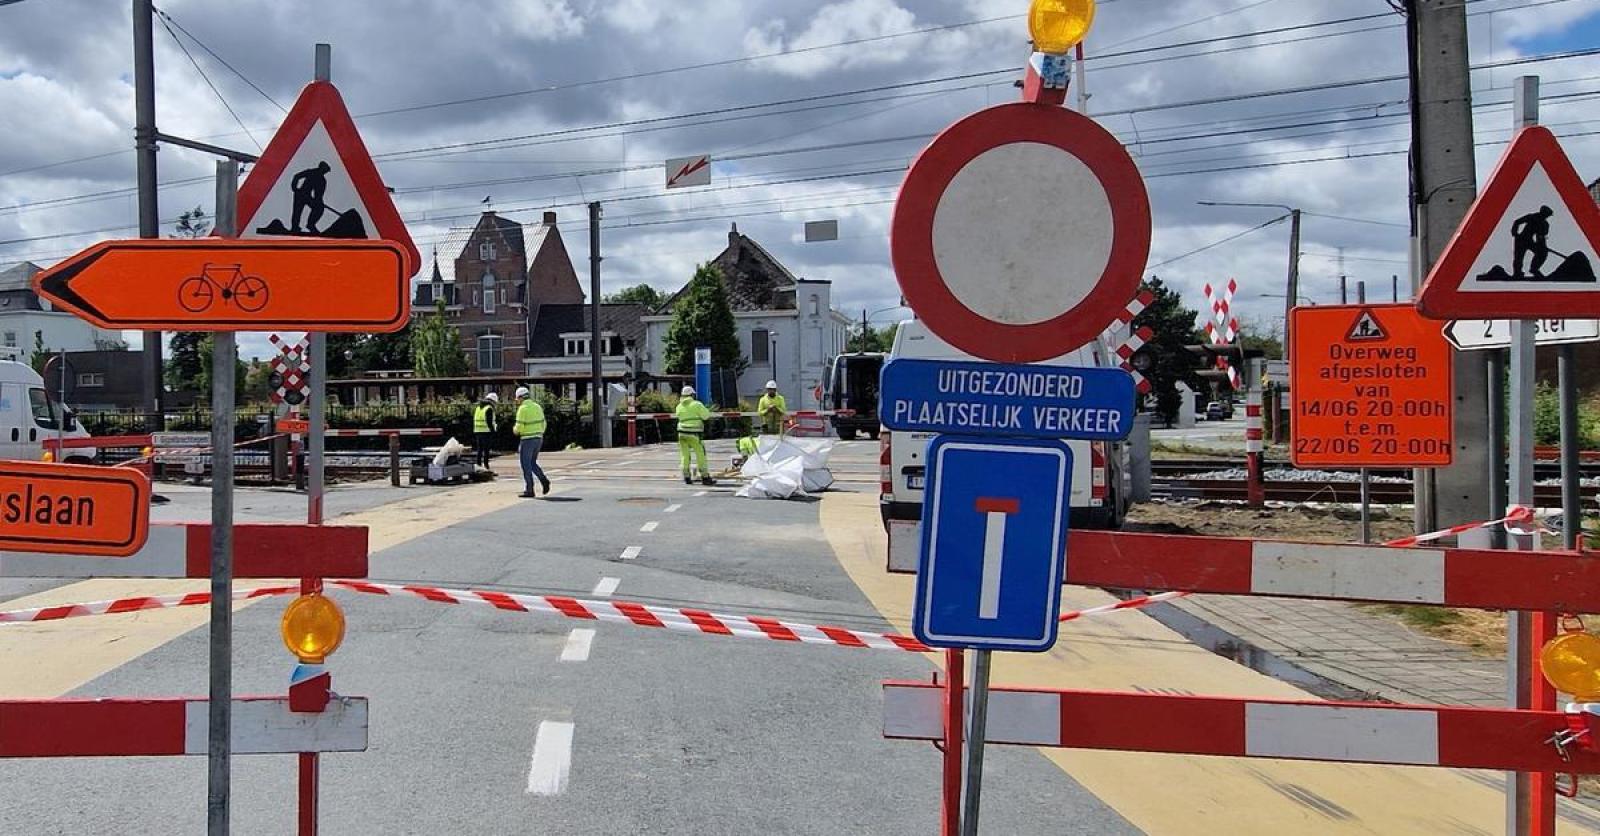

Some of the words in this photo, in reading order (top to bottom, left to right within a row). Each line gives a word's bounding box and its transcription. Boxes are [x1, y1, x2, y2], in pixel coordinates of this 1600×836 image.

[1483, 319, 1493, 338] 2
[1330, 344, 1417, 362] Overweg
[1320, 363, 1427, 382] afgesloten
[938, 369, 1083, 398] UITGEZONDERD
[1355, 384, 1390, 397] van
[894, 399, 1023, 429] PLAATSELIJK
[1033, 406, 1121, 433] VERKEER
[1301, 400, 1358, 417] 14/06
[1366, 400, 1445, 417] 20:00h
[1344, 420, 1400, 436] t.e.m.
[1297, 438, 1360, 454] 22/06
[1371, 438, 1450, 455] 20:00h
[0, 483, 94, 526] slaan
